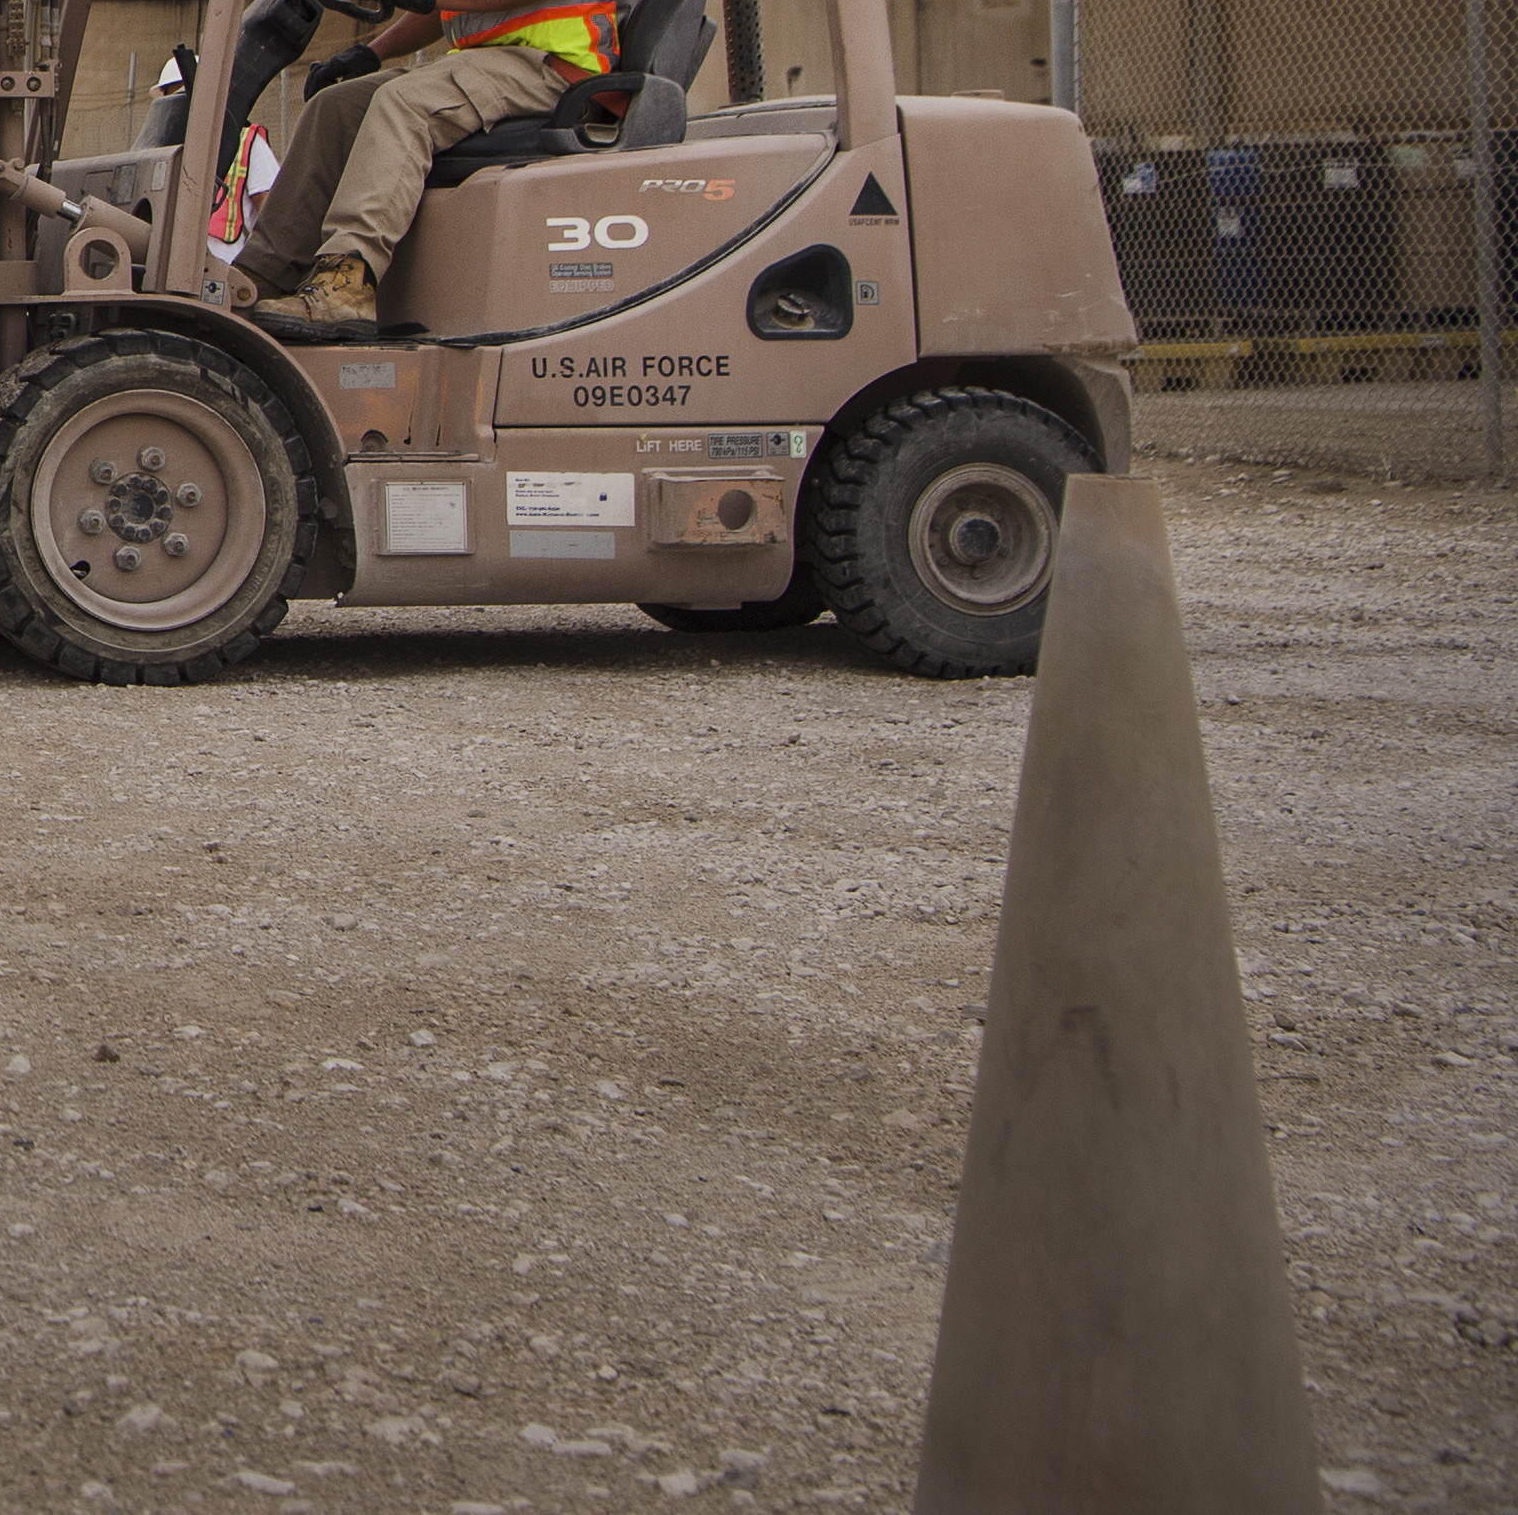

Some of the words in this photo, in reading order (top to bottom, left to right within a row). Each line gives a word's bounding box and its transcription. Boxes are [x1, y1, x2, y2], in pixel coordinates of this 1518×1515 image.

[639, 180, 736, 201] PRO5
[546, 215, 649, 252] 30
[642, 355, 730, 377] FORCE
[573, 385, 691, 407] 09E0347
[669, 439, 702, 452] HERE
